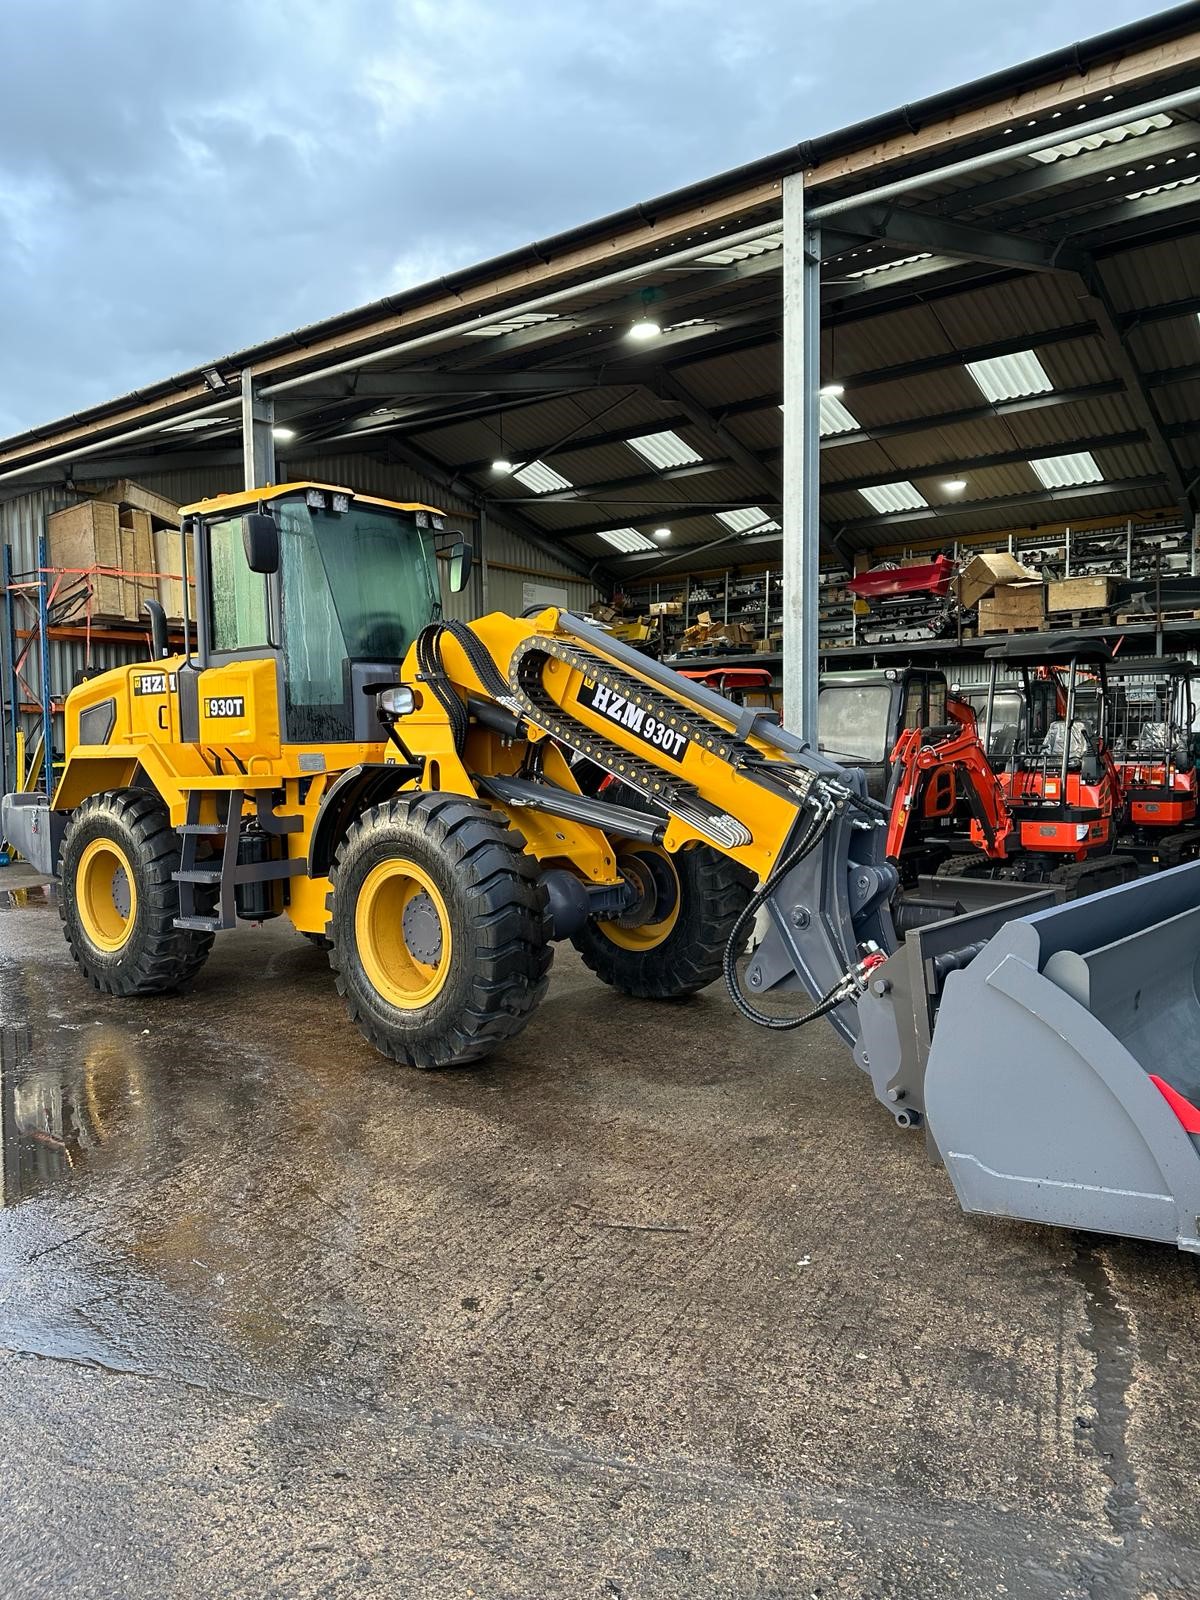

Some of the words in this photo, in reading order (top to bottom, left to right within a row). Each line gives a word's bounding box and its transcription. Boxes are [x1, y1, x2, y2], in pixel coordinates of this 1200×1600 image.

[210, 699, 243, 716] 930T
[591, 683, 647, 733] HZM
[643, 717, 687, 756] 930T
